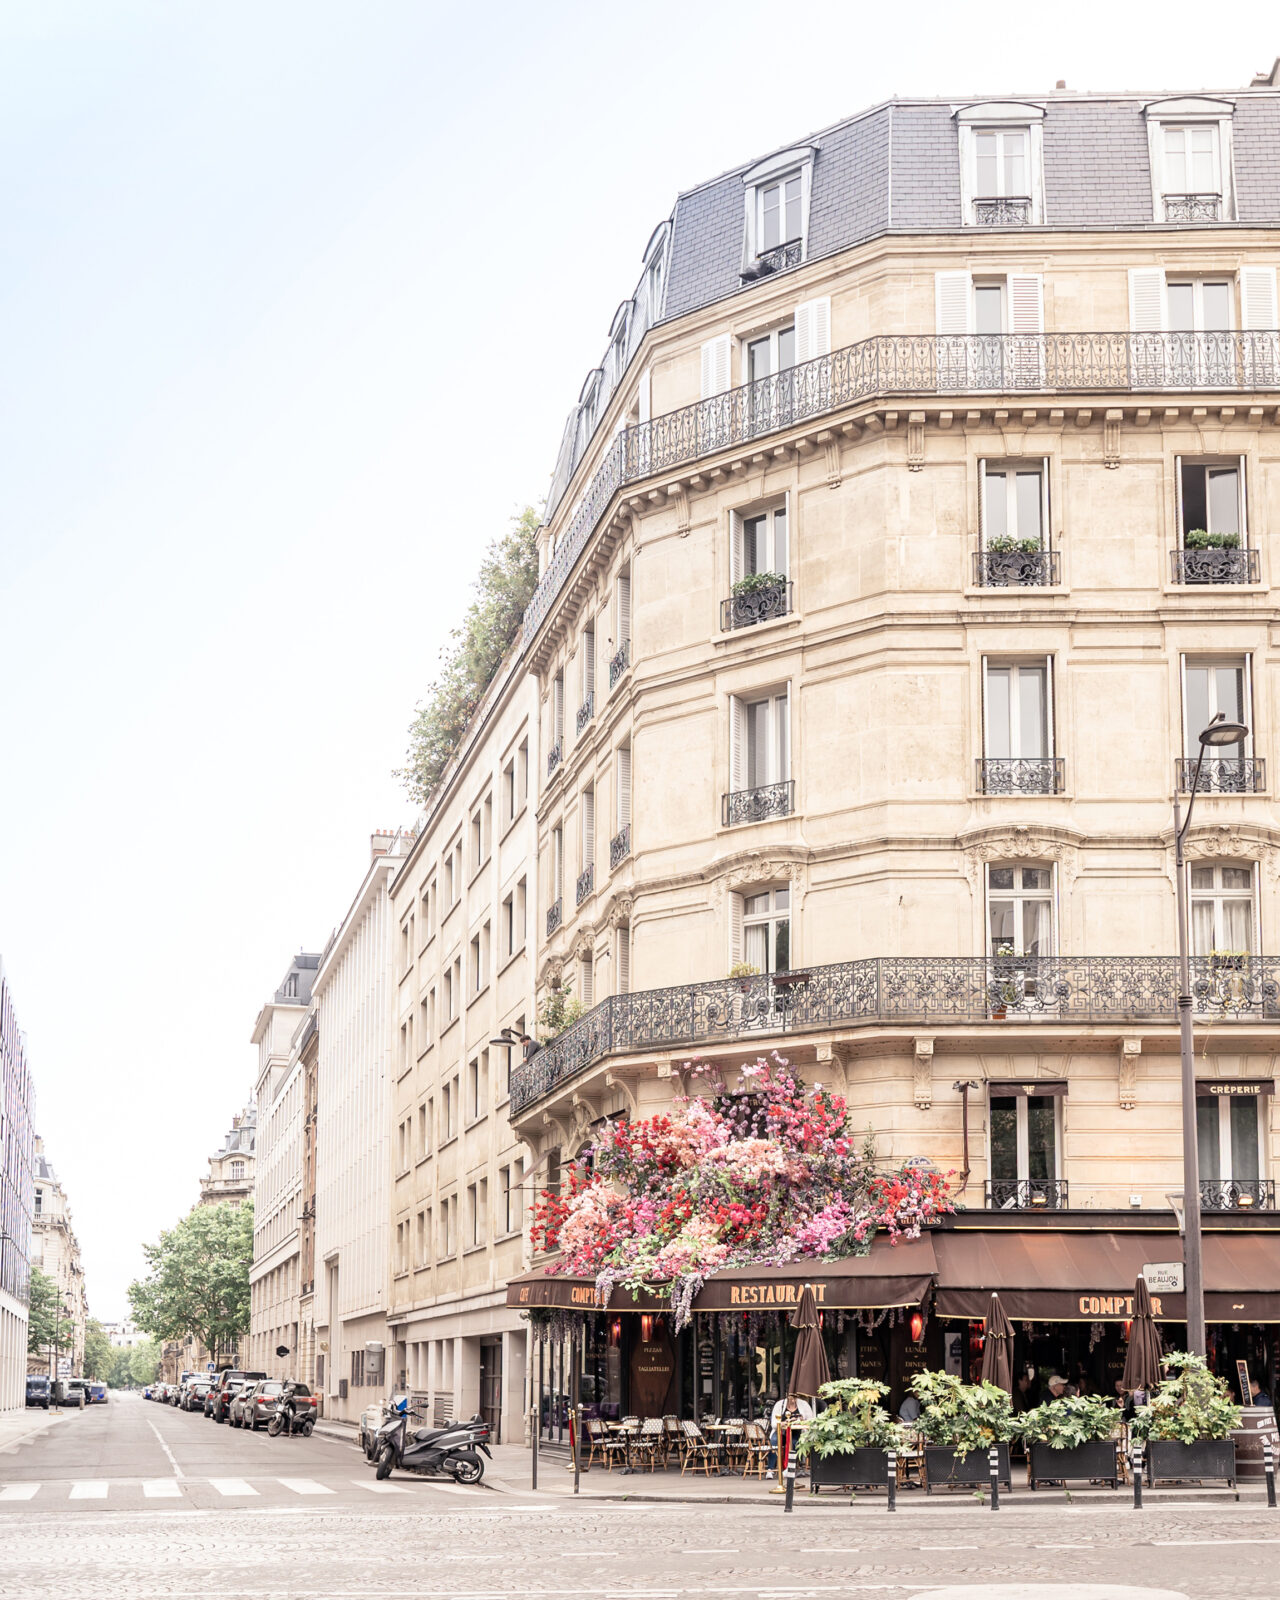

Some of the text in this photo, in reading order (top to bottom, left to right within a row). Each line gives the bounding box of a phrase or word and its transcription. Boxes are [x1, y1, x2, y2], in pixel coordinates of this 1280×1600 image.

[1210, 1084, 1261, 1094] CRÊPERIE
[1148, 1275, 1179, 1284] BEAUJON
[571, 1286, 606, 1304] COMPT
[1079, 1296, 1164, 1315] COMPTR
